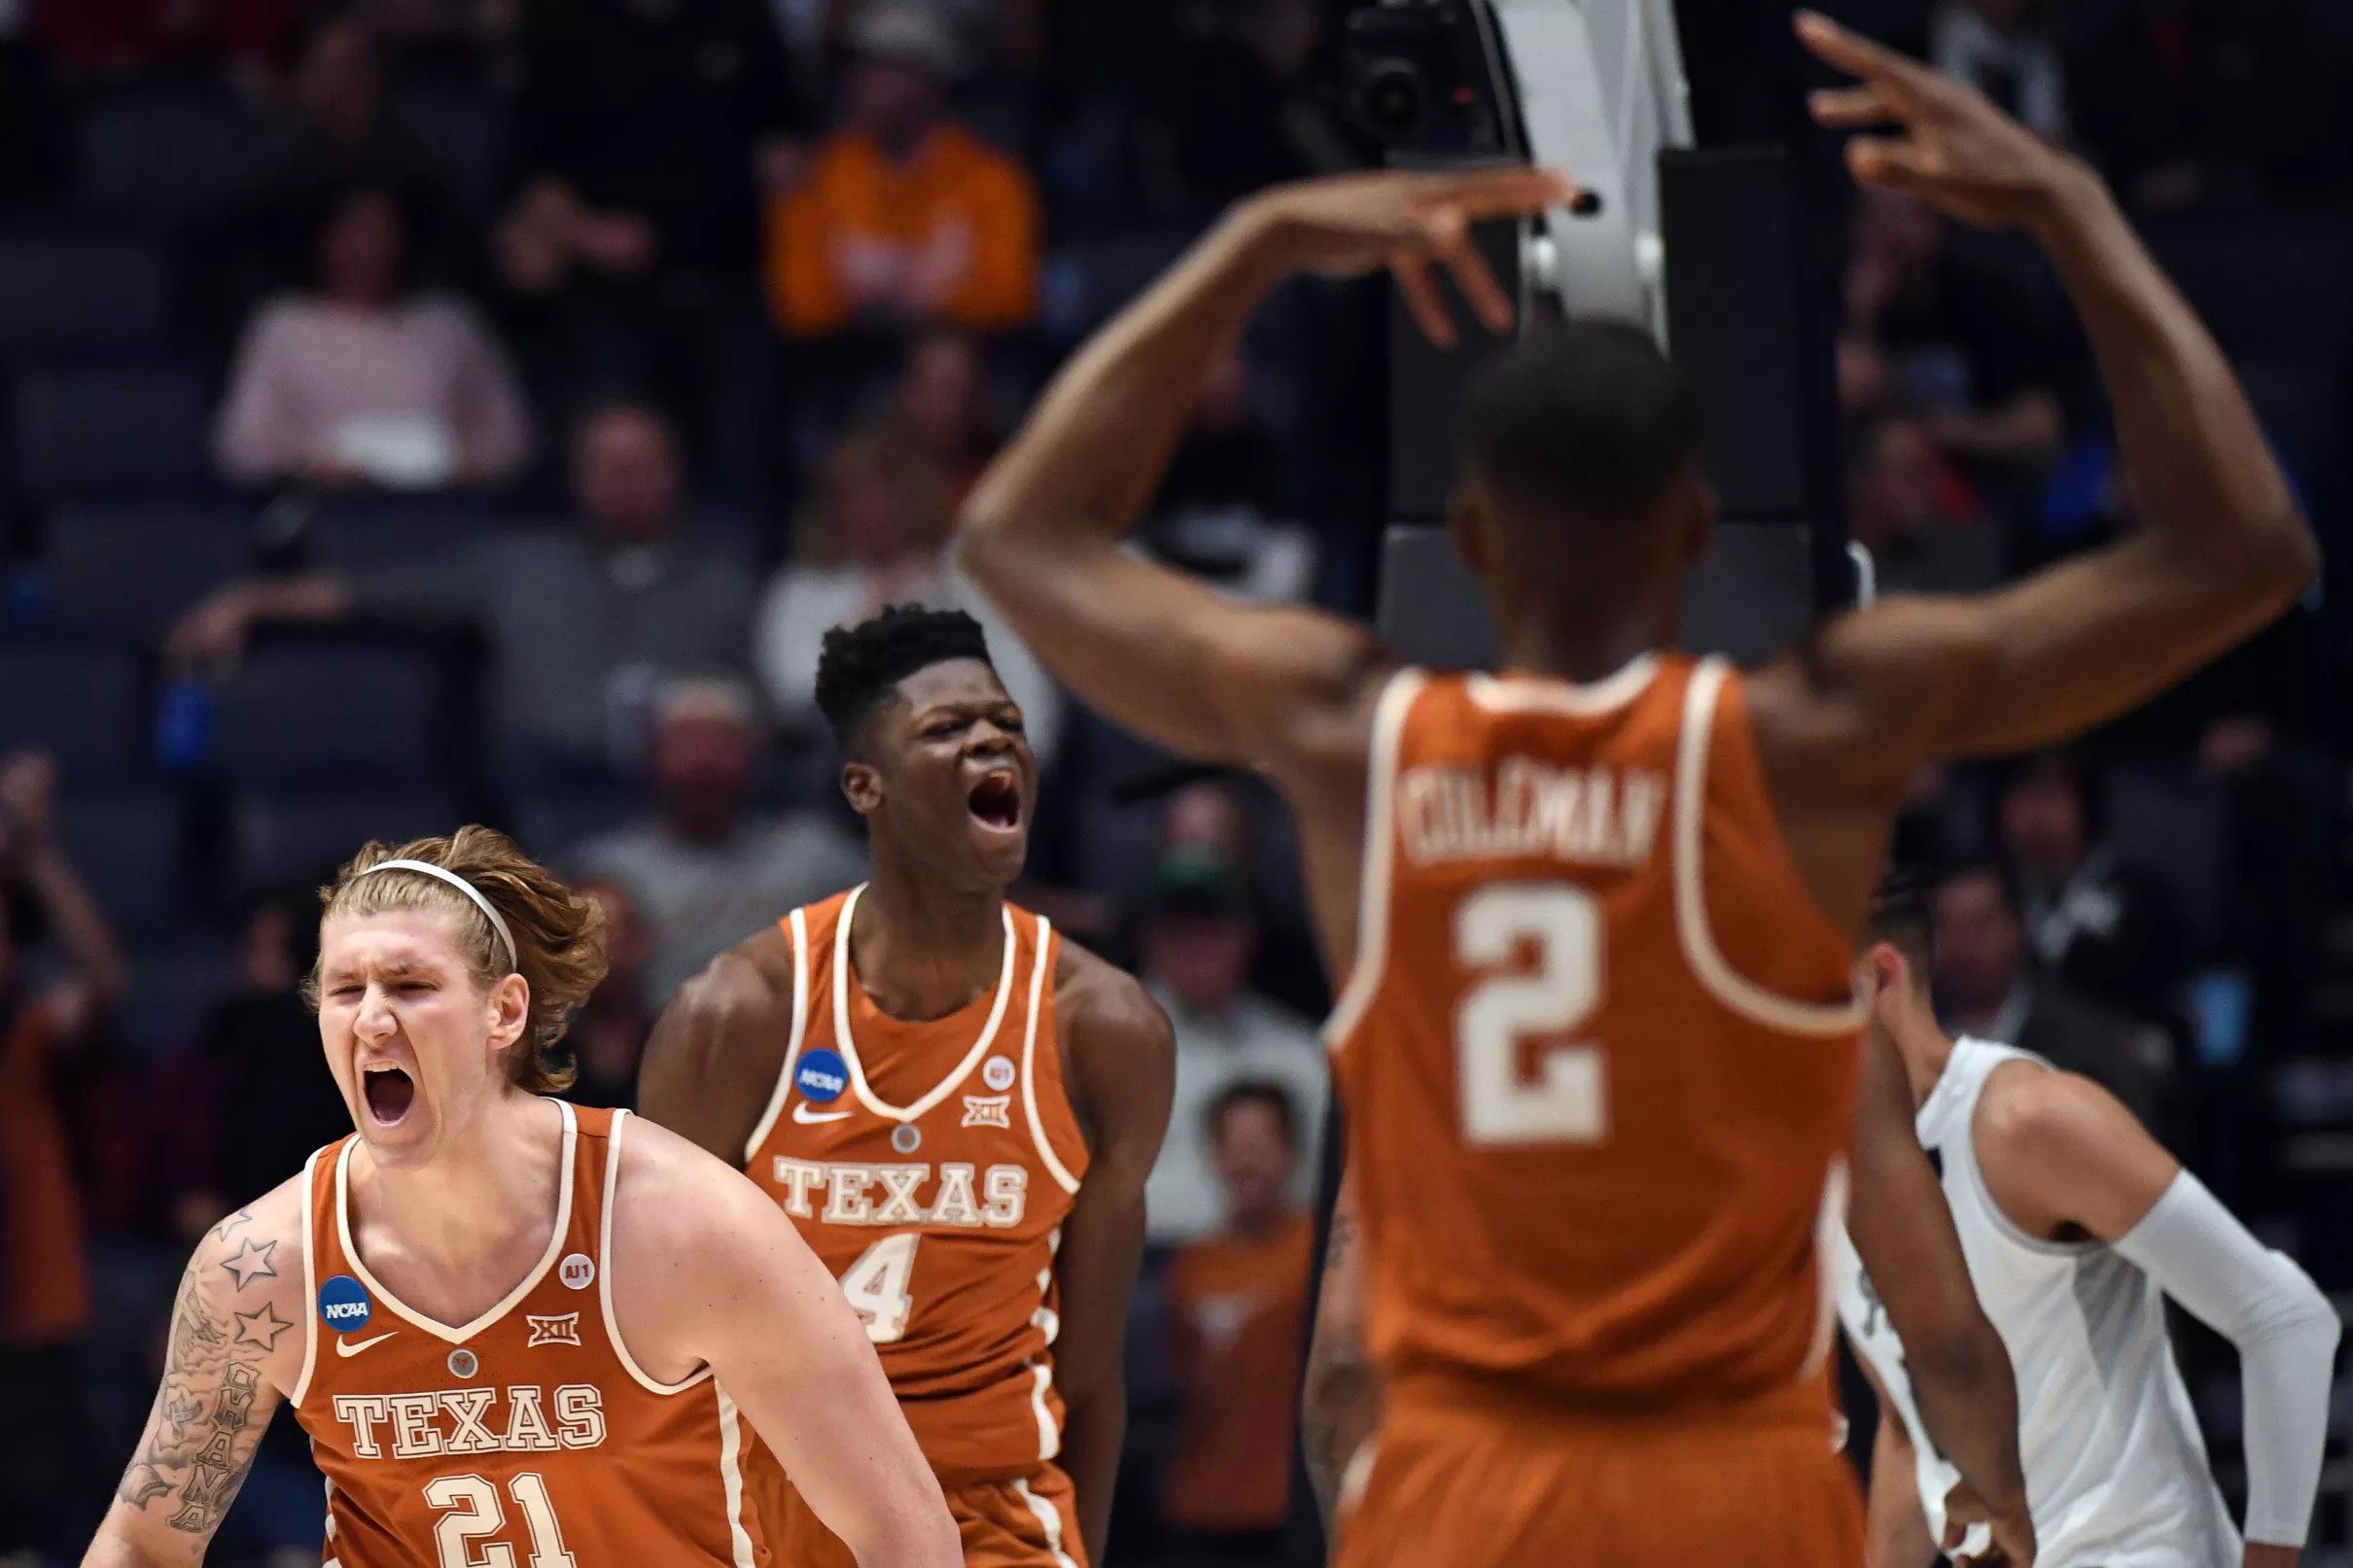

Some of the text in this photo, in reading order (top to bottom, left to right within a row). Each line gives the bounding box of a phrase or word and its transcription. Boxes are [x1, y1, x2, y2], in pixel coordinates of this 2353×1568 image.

[1453, 882, 1608, 1149] 2
[773, 1155, 1028, 1228] TEXAS
[326, 1301, 369, 1319] NCAA
[841, 1231, 922, 1343] 4
[168, 1361, 260, 1534] OHANA
[333, 1384, 607, 1459] TEXAS
[422, 1472, 578, 1568] 21
